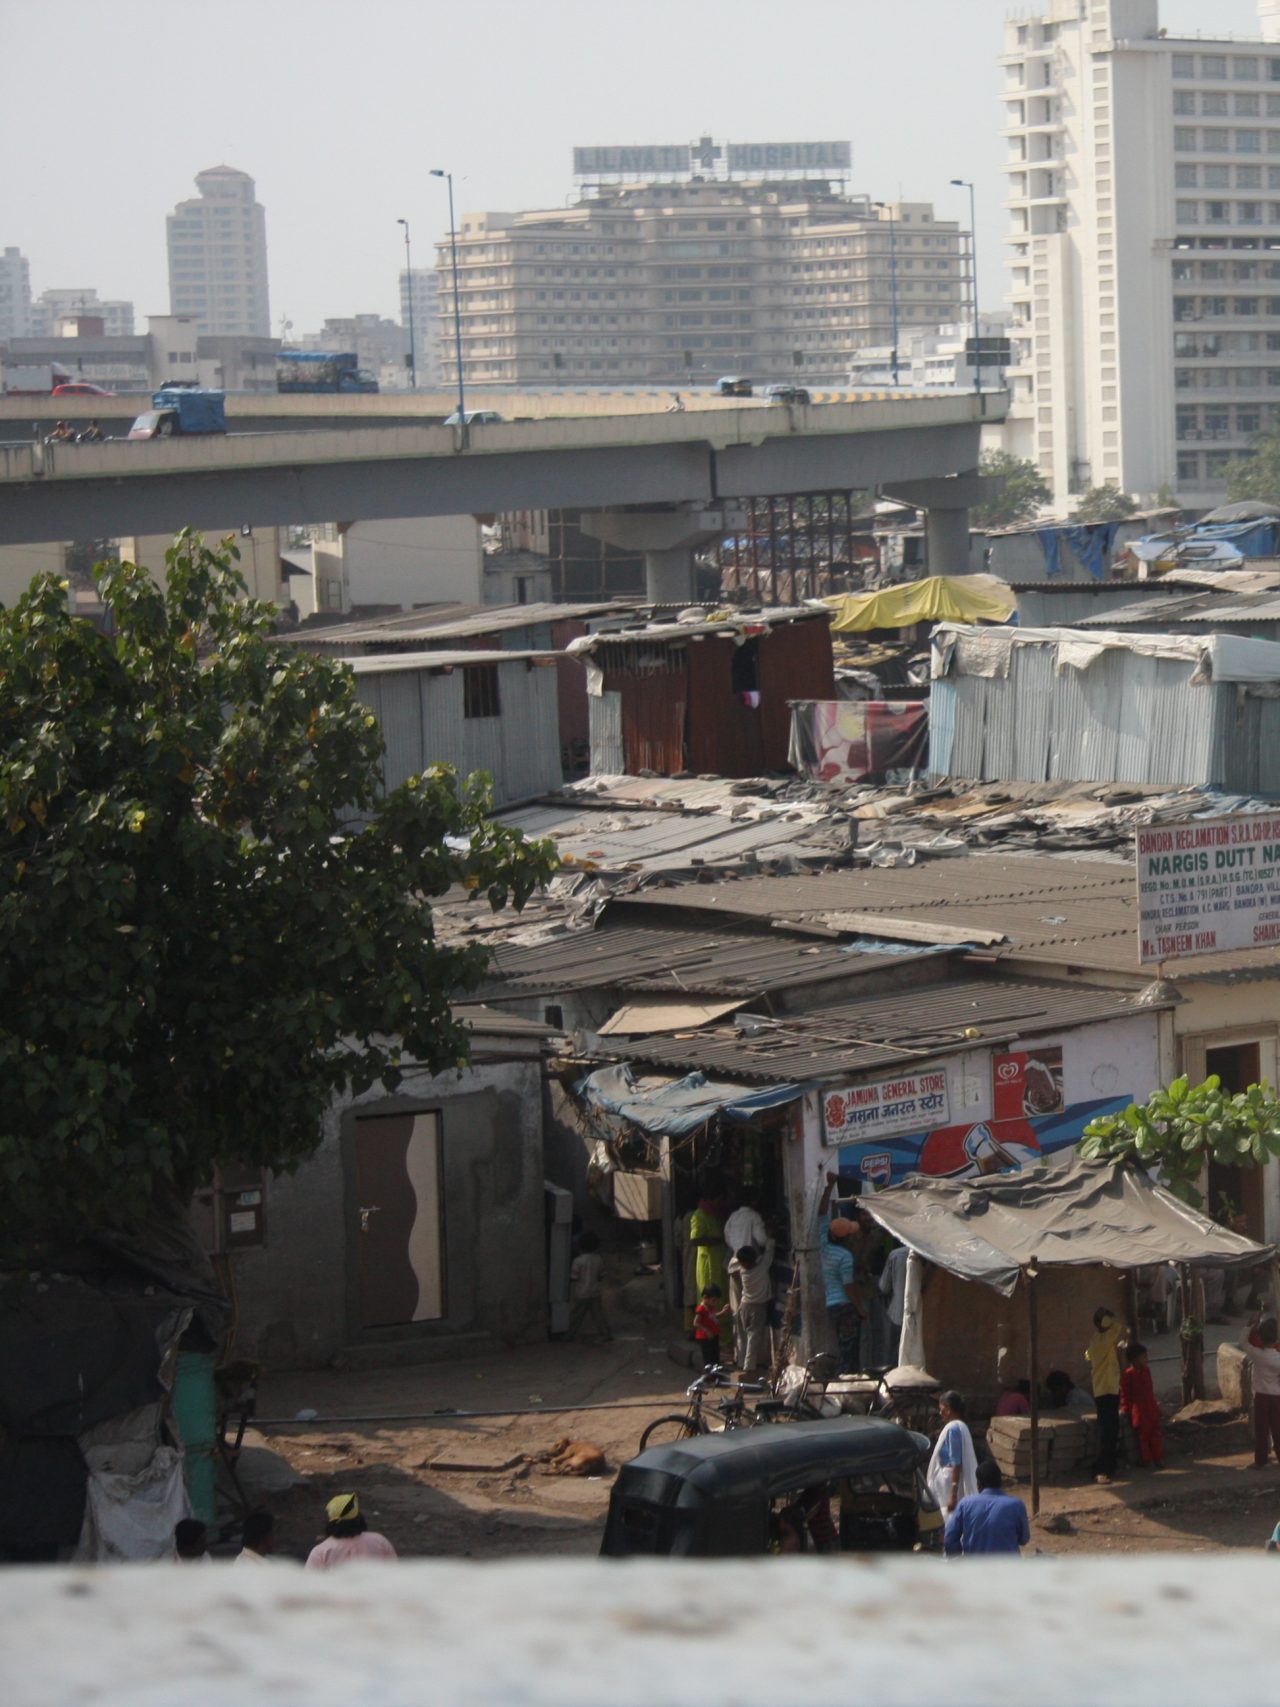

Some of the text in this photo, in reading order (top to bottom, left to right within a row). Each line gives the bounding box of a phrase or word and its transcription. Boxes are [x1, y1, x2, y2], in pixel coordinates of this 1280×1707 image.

[732, 143, 847, 169] HOSPITAL
[1140, 832, 1173, 855] BANDRA
[1176, 826, 1229, 850] RECLAMATION
[1149, 853, 1208, 876] NARGIS
[1215, 847, 1256, 869] DUTT
[1235, 884, 1264, 896] BANDRA
[1158, 935, 1193, 955] TASNEEM
[1195, 931, 1217, 950] KHAN
[846, 1073, 945, 1109] JAMUNA GENERAL STORE
[880, 1103, 916, 1120] जनरल
[864, 1157, 888, 1169] PEPSI
